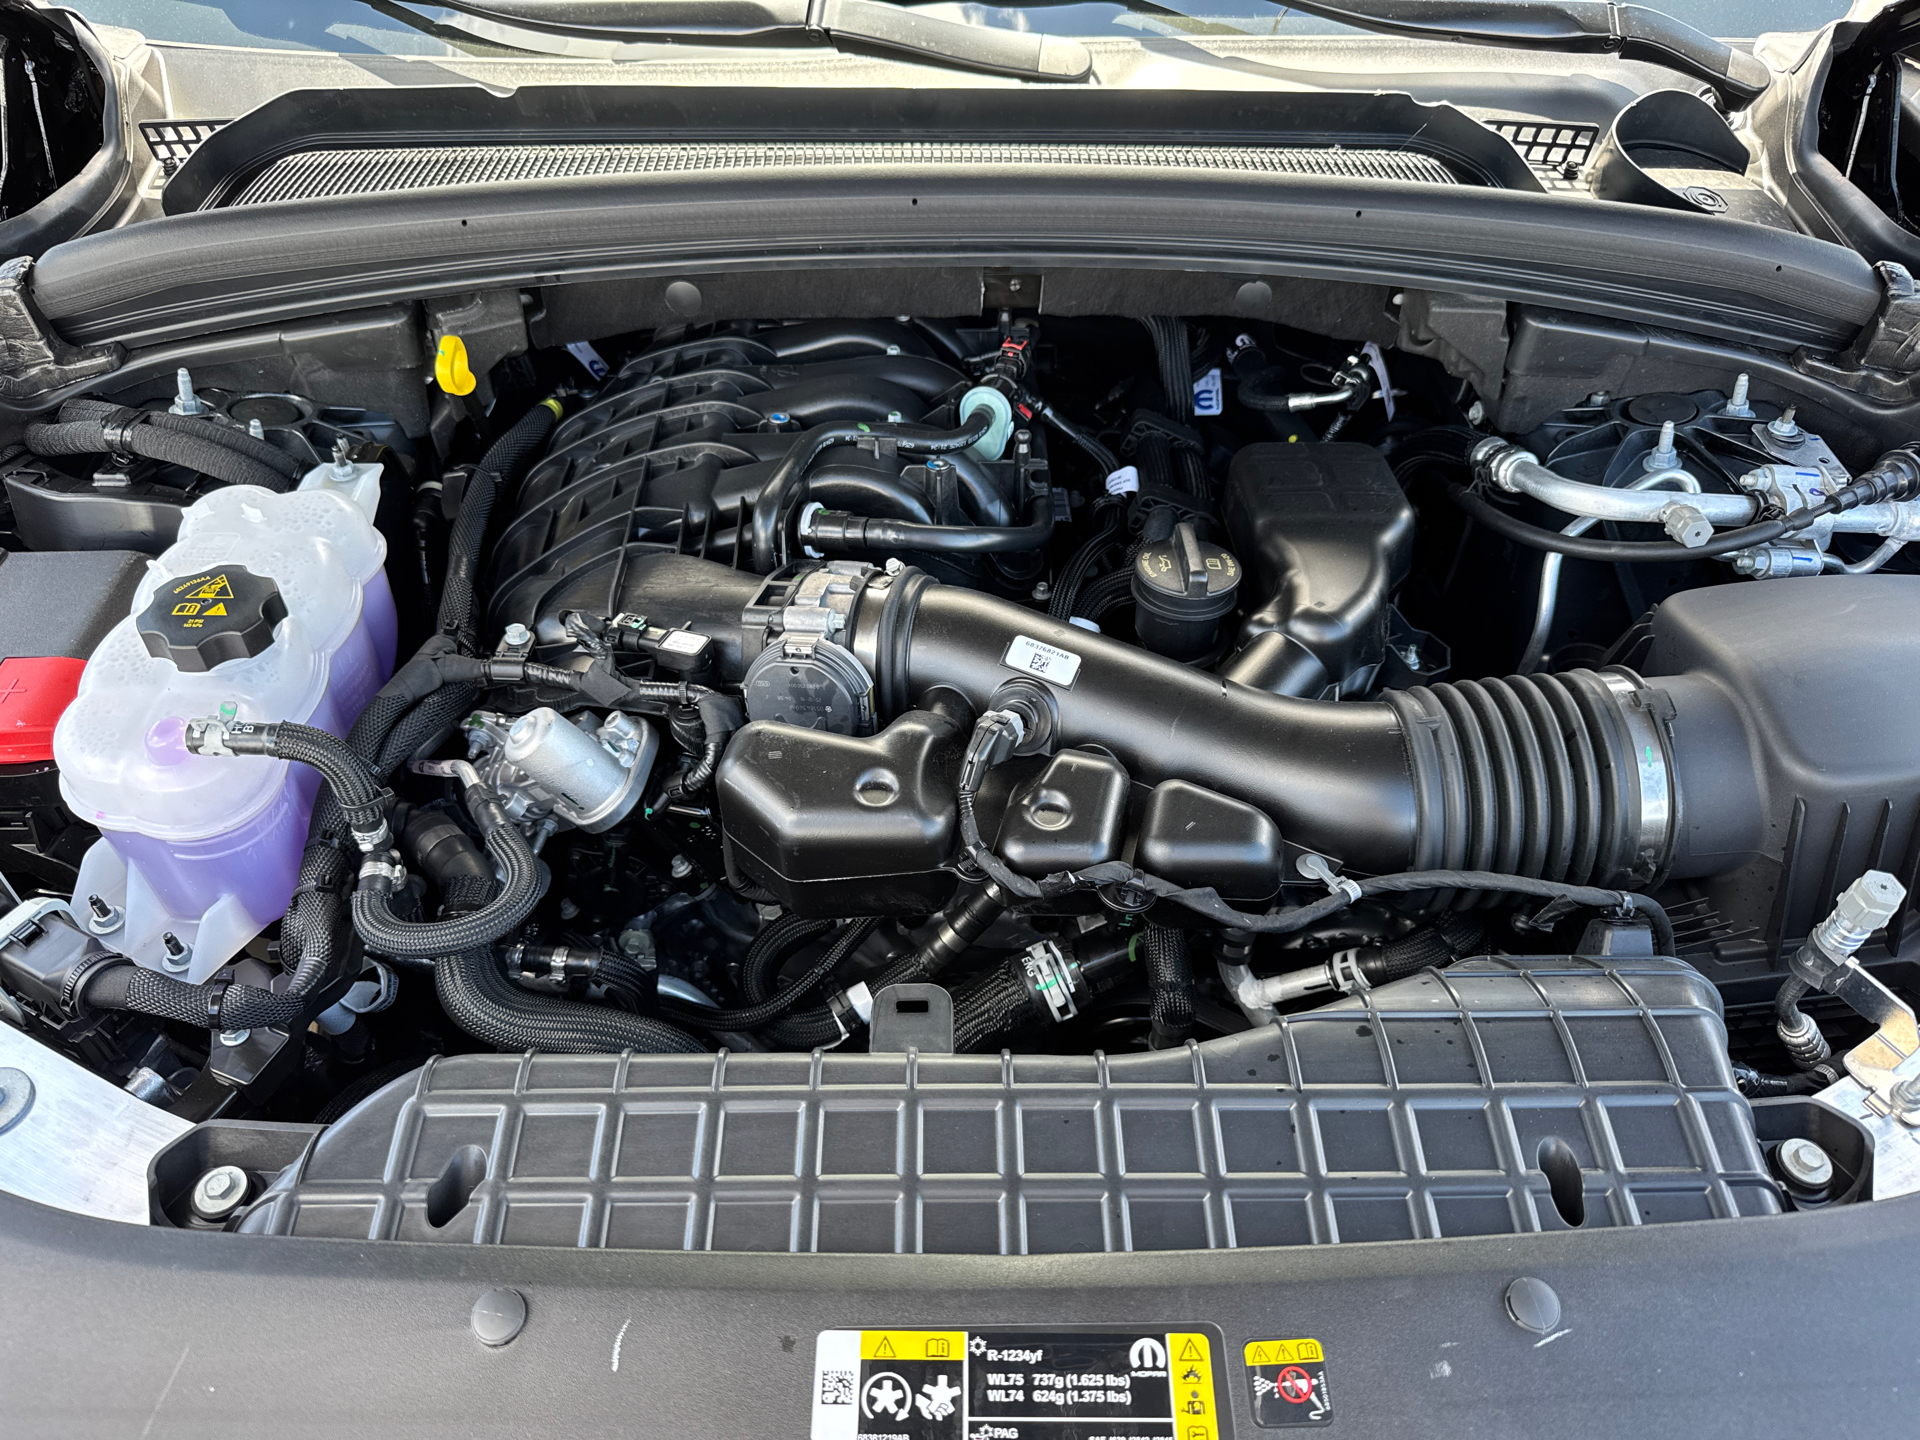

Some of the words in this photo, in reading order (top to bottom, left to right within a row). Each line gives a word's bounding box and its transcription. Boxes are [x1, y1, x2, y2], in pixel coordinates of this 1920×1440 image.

[1142, 560, 1158, 578] ENGINE
[1025, 640, 1070, 660] 68376821AB
[1021, 956, 1036, 978] ENG
[986, 1349, 1043, 1364] R-1234yf
[986, 1374, 1025, 1386] WL75
[1032, 1374, 1064, 1388] 737g
[1066, 1373, 1104, 1388] (1.625
[1105, 1373, 1131, 1388] lbs)
[986, 1390, 1025, 1402] WL74
[1032, 1390, 1064, 1405] 624g
[1066, 1390, 1105, 1405] (1.375
[1106, 1390, 1132, 1405] lbs)
[993, 1428, 1019, 1439] PAG
